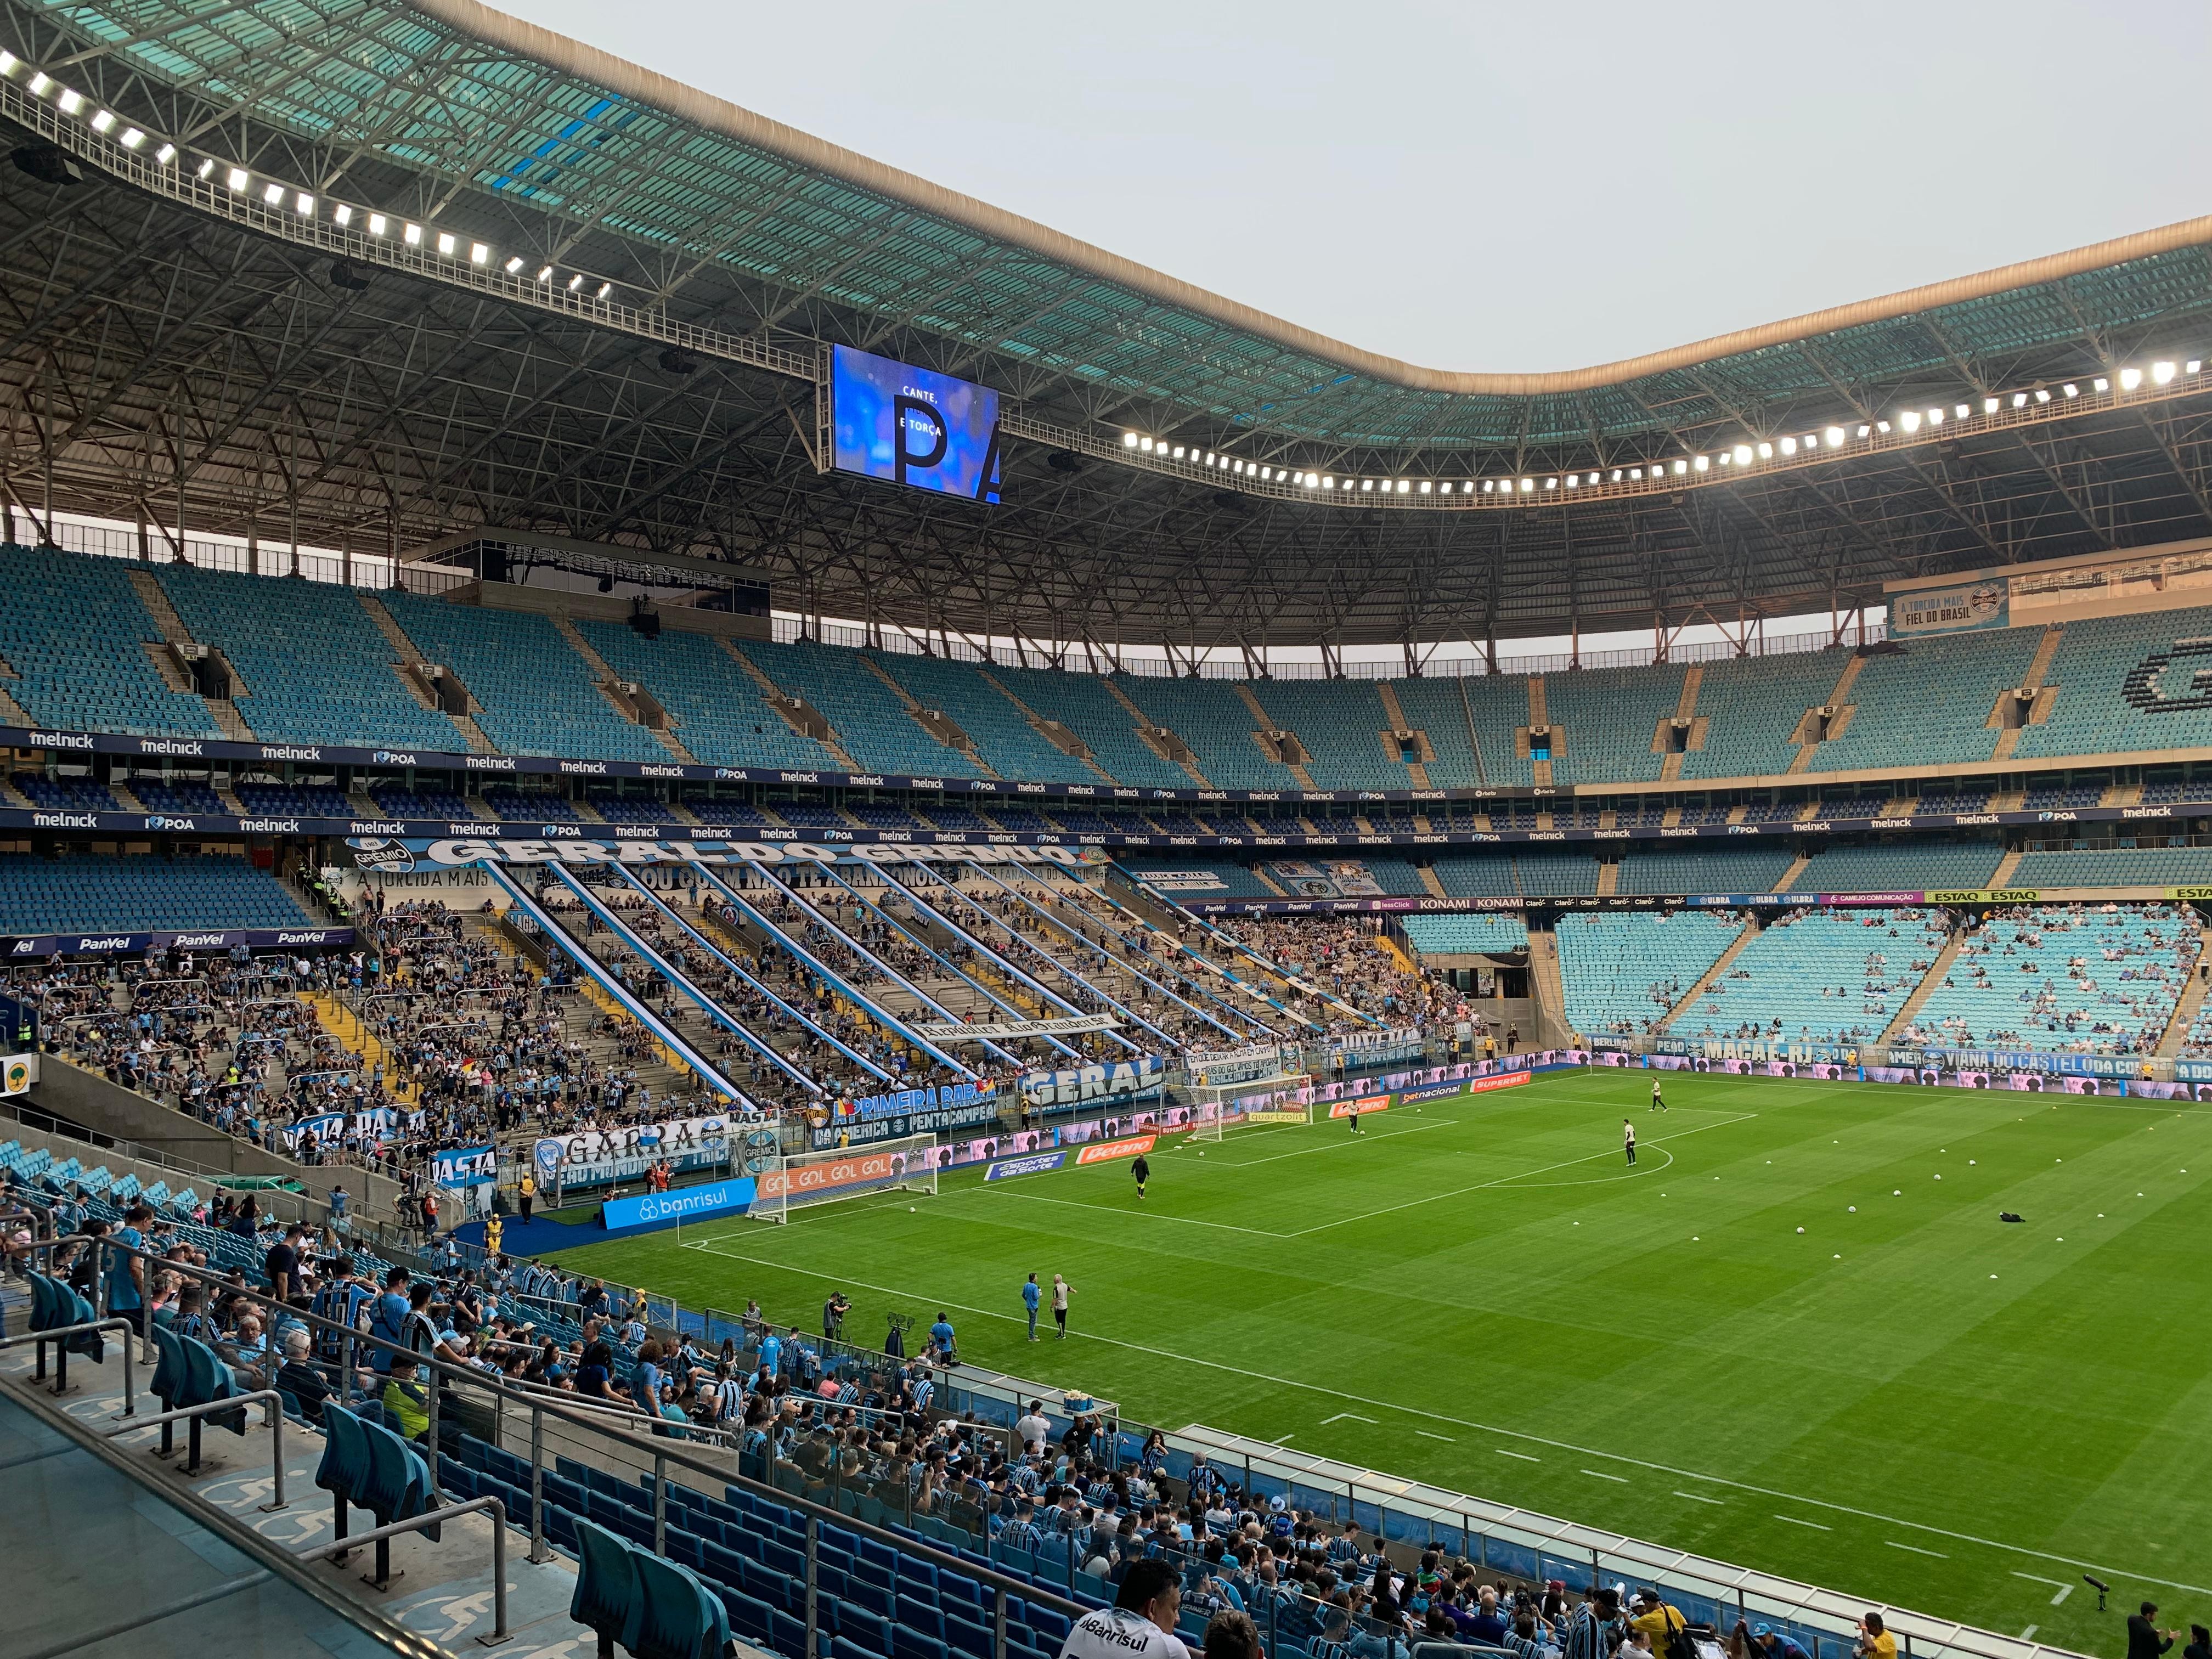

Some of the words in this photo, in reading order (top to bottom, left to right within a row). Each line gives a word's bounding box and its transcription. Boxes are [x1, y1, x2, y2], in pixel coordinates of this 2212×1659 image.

[903, 386, 938, 404] CANTE,
[900, 417, 905, 427] E
[909, 419, 941, 436] TORÇA
[1901, 603, 1906, 613] A
[1909, 599, 1942, 612] TORCIDA
[1944, 595, 1964, 607] MAIS
[1906, 612, 1923, 625] FIEL
[1927, 611, 1937, 623] DO
[1941, 607, 1971, 621] BRASIL
[30, 732, 94, 749] melnick
[140, 740, 202, 755] melnick
[262, 746, 320, 761] melnick
[391, 755, 416, 765] POA
[466, 756, 516, 769] melnick
[560, 761, 606, 774] melnick
[641, 765, 684, 777] melnick
[728, 771, 748, 780] POA
[781, 771, 818, 783] melnick
[849, 775, 884, 786] melnick
[912, 778, 944, 788] melnick
[981, 782, 996, 791] POA
[1017, 783, 1046, 793] melnick
[1068, 785, 1095, 794] melnick
[1114, 788, 1139, 797] melnick
[1198, 791, 1227, 799] melnick
[1412, 791, 1446, 799] melnick
[1249, 792, 1279, 800] melnick
[1302, 792, 1334, 800] melnick
[2054, 812, 2076, 821] POA
[2123, 806, 2171, 819] melnick
[32, 812, 97, 828] melnick
[165, 819, 194, 830] POA
[1871, 817, 1911, 827] melnick
[1956, 813, 1999, 825] melnick
[239, 819, 299, 832] melnick
[350, 821, 405, 834] melnick
[449, 823, 500, 836] melnick
[615, 825, 659, 837] melnick
[1661, 826, 1698, 836] melnick
[1740, 826, 1759, 834] POA
[1792, 821, 1831, 832] melnick
[558, 827, 581, 836] POA
[691, 827, 731, 839] melnick
[760, 828, 798, 839] melnick
[836, 832, 853, 840] POA
[879, 831, 912, 841] melnick
[1528, 831, 1565, 840] melnick
[1594, 828, 1630, 838] melnick
[935, 832, 966, 843] melnick
[988, 833, 1017, 843] melnick
[1080, 834, 1105, 844] melnick
[1125, 835, 1150, 844] melnick
[1170, 836, 1197, 845] melnick
[1255, 836, 1286, 845] melnick
[1305, 835, 1338, 845] melnick
[1358, 834, 1392, 844] melnick
[1413, 833, 1448, 843] melnick
[355, 848, 408, 864] GRÊMIO
[428, 839, 729, 865] GERAL
[726, 842, 838, 862] DO
[357, 872, 368, 887] A
[796, 866, 821, 887] TE
[1708, 896, 1730, 904] ULBRA
[1756, 895, 1778, 904] ULBRA
[1791, 895, 1814, 903] ULBRA
[1866, 894, 1914, 902] COMUNICAÇÃO
[1935, 891, 1979, 901] ESTAQ
[1991, 890, 2037, 901] ESTAQ
[1420, 900, 1470, 909] KONAMI
[1477, 899, 1523, 908] KONAMI
[176, 934, 224, 946] PanVel
[278, 932, 325, 944] PanVel
[80, 938, 131, 950] PanVel
[1945, 1050, 1989, 1068] VIANA
[1993, 1052, 2013, 1069] DO
[1476, 1073, 1528, 1088] SUPERBET
[1403, 1084, 1460, 1103] betnacional
[1251, 1112, 1303, 1121] quartzolit
[1163, 1124, 1189, 1133] SUPERBET
[1086, 1140, 1150, 1160] Betano
[432, 1152, 497, 1183] RASTA
[999, 1154, 1059, 1172] Esportes
[765, 1175, 794, 1193] GOL
[799, 1170, 826, 1187] GOL
[832, 1164, 857, 1181] GOL
[862, 1158, 887, 1175] GOL
[661, 1188, 727, 1215] banrisul
[1181, 1603, 1211, 1617] RENNER
[1088, 1618, 1149, 1652] Banrisul
